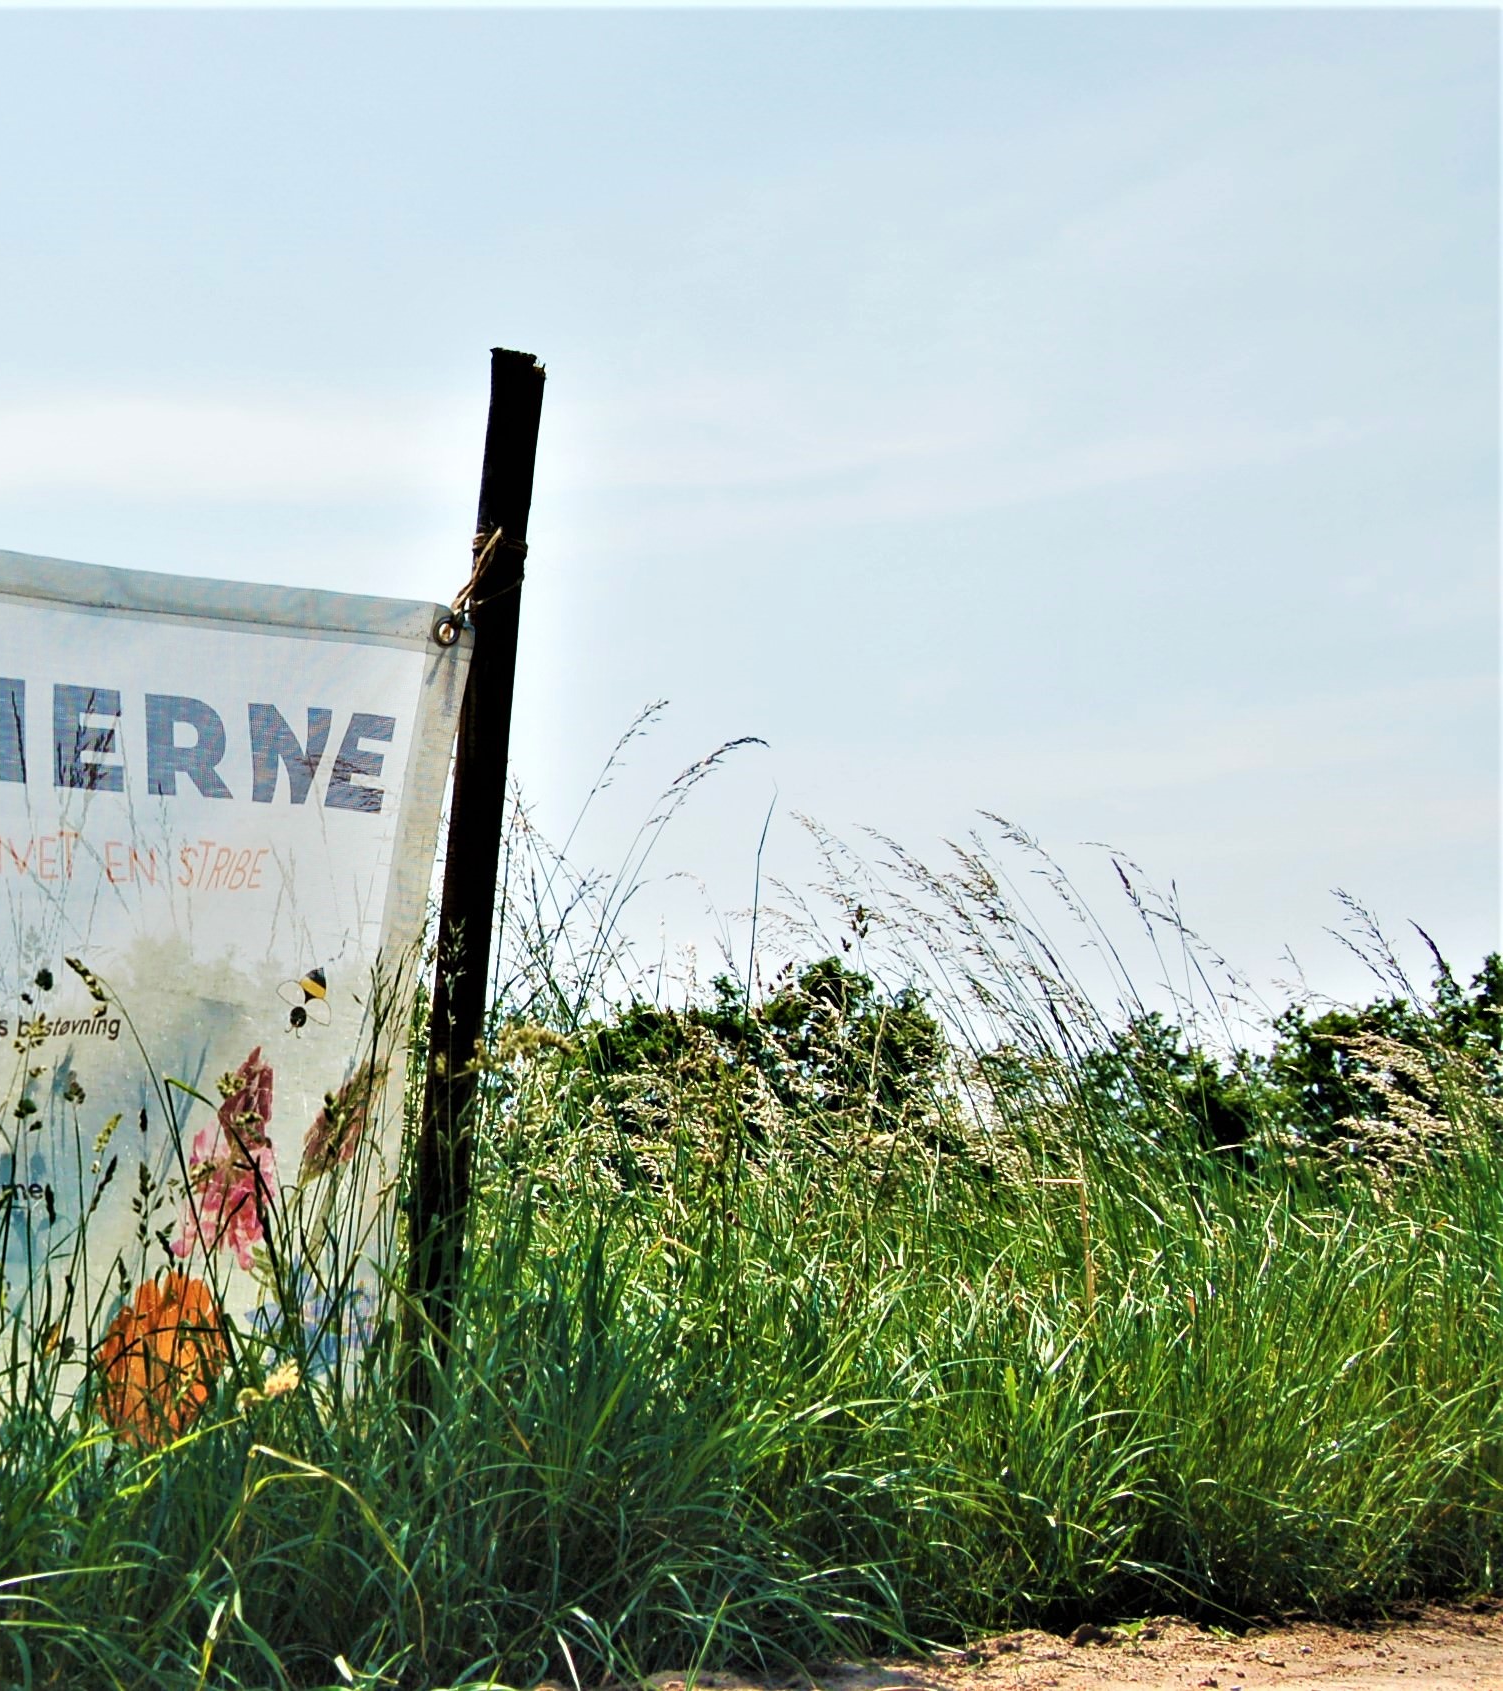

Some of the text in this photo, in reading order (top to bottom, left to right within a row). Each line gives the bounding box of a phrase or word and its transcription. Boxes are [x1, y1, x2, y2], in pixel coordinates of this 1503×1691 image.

[104, 840, 159, 886] EN
[178, 839, 270, 892] STRIBE
[17, 1013, 121, 1040] bstøvning
